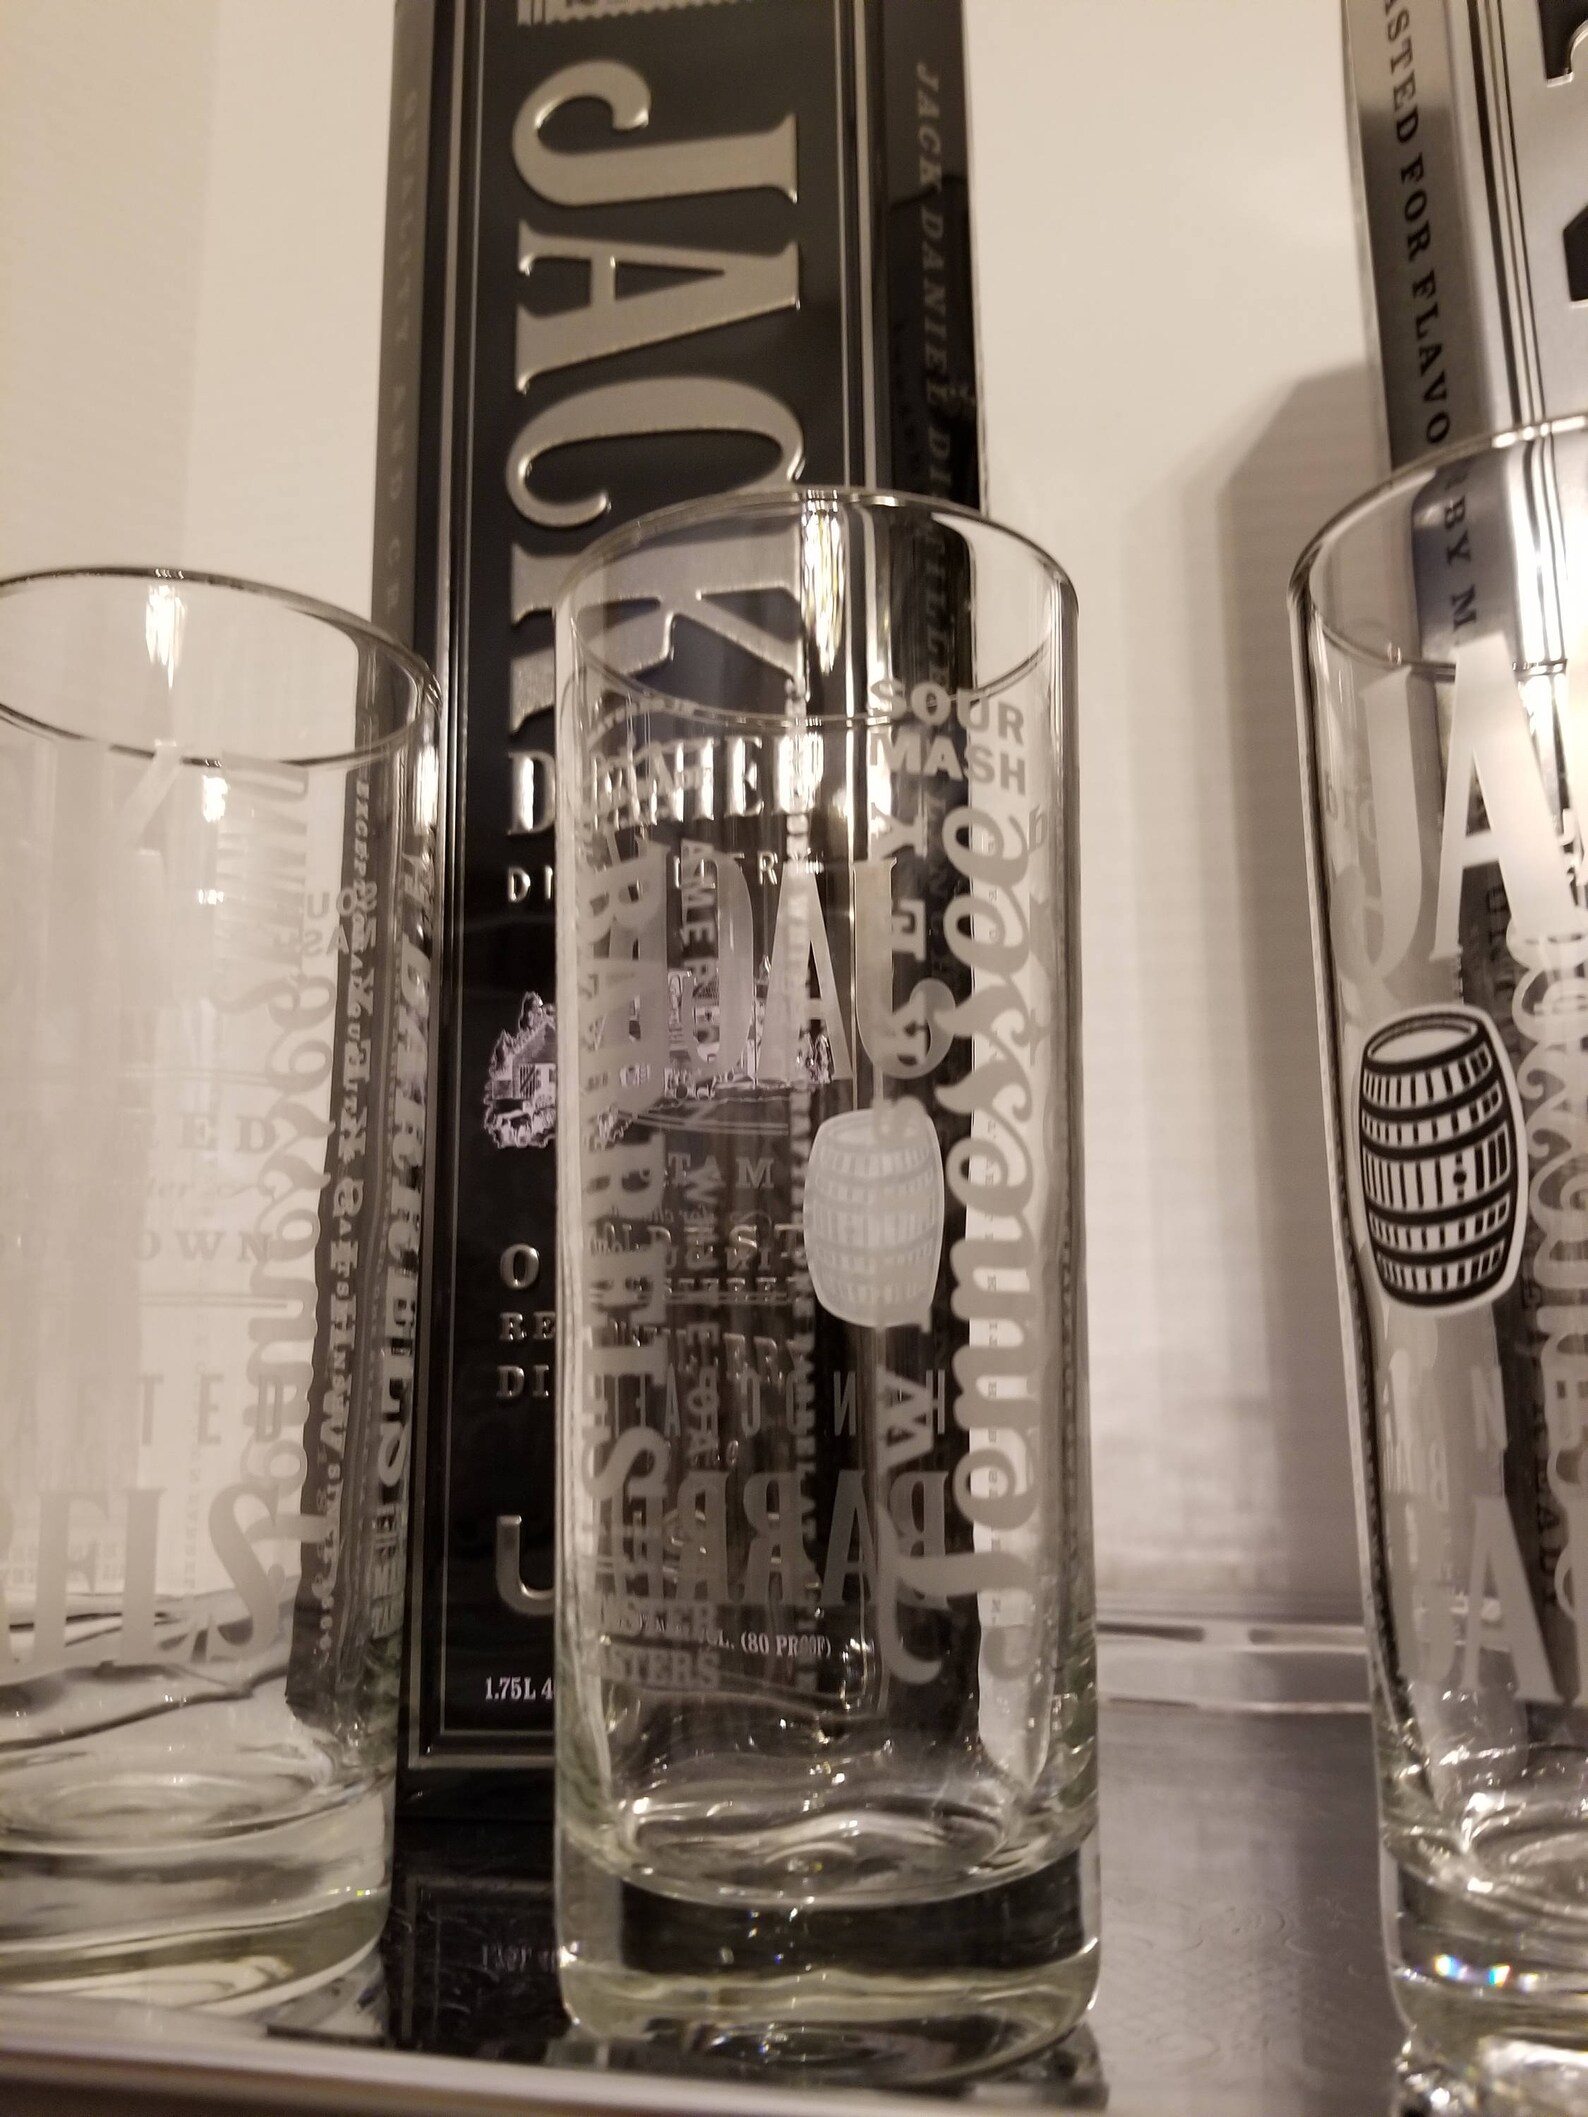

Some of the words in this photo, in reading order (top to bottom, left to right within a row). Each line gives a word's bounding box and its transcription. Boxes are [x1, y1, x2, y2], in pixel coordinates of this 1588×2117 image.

[505, 58, 806, 738] JACK
[1400, 152, 1432, 265] FOR
[1444, 496, 1473, 567] BY
[869, 678, 1025, 747] SOUR
[869, 732, 1026, 797] MASH
[580, 842, 672, 1502] BARRELS
[483, 1676, 537, 1701] 1.75L
[740, 1632, 770, 1656] (80
